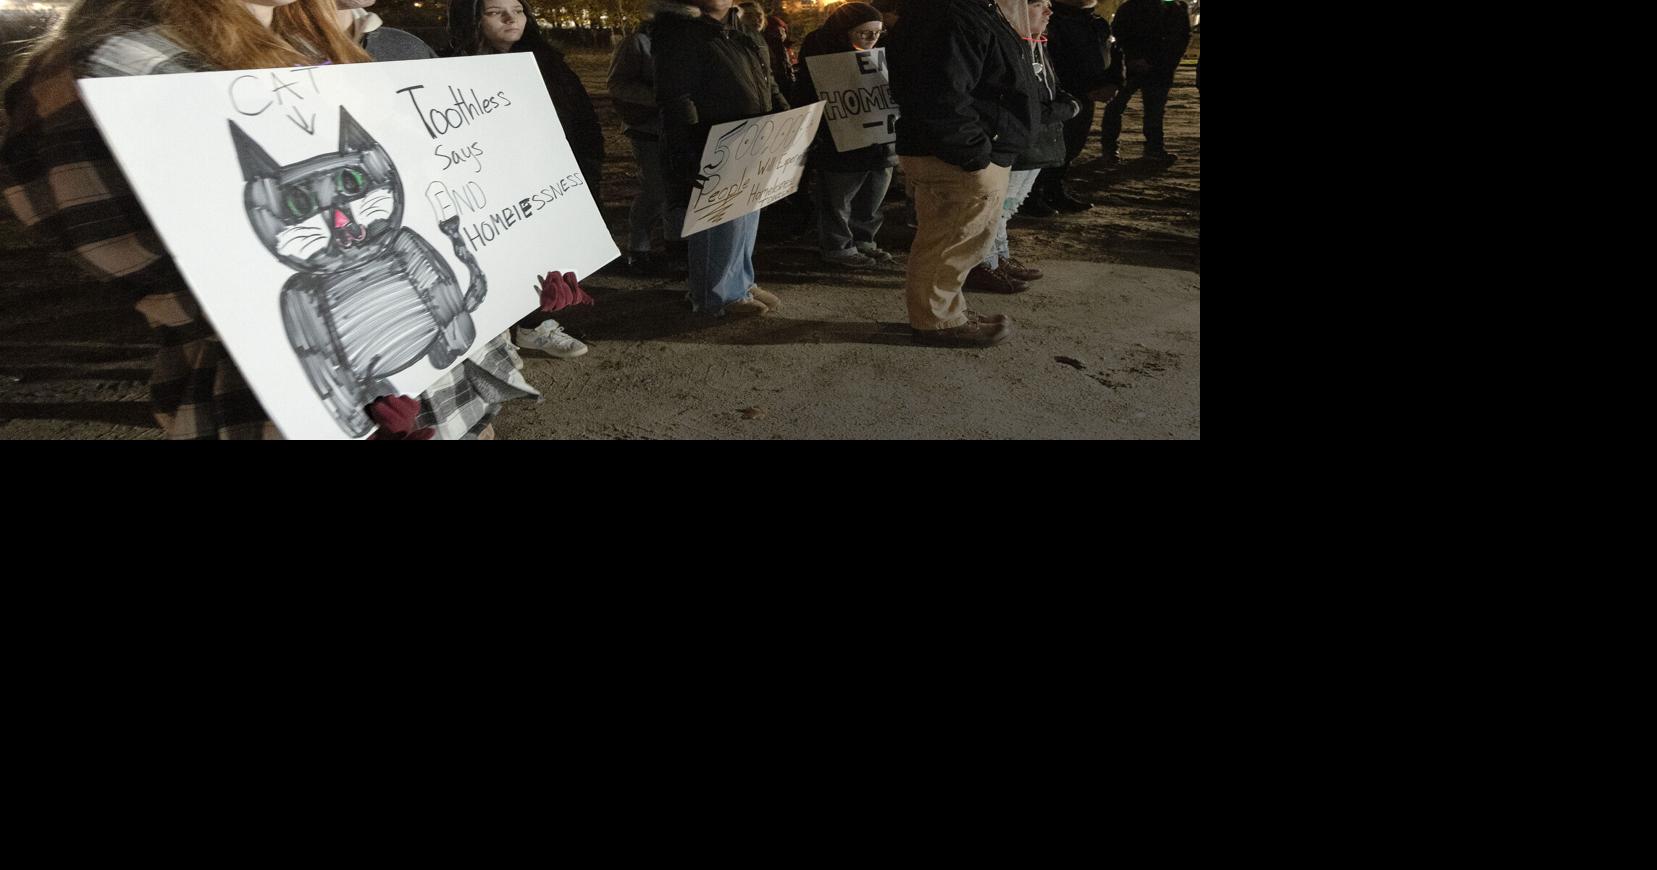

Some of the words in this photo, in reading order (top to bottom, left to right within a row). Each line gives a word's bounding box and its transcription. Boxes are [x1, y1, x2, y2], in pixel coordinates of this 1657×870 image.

[228, 66, 320, 116] CAT
[396, 84, 512, 139] Toothless
[434, 141, 484, 173] Says
[433, 181, 487, 222] END
